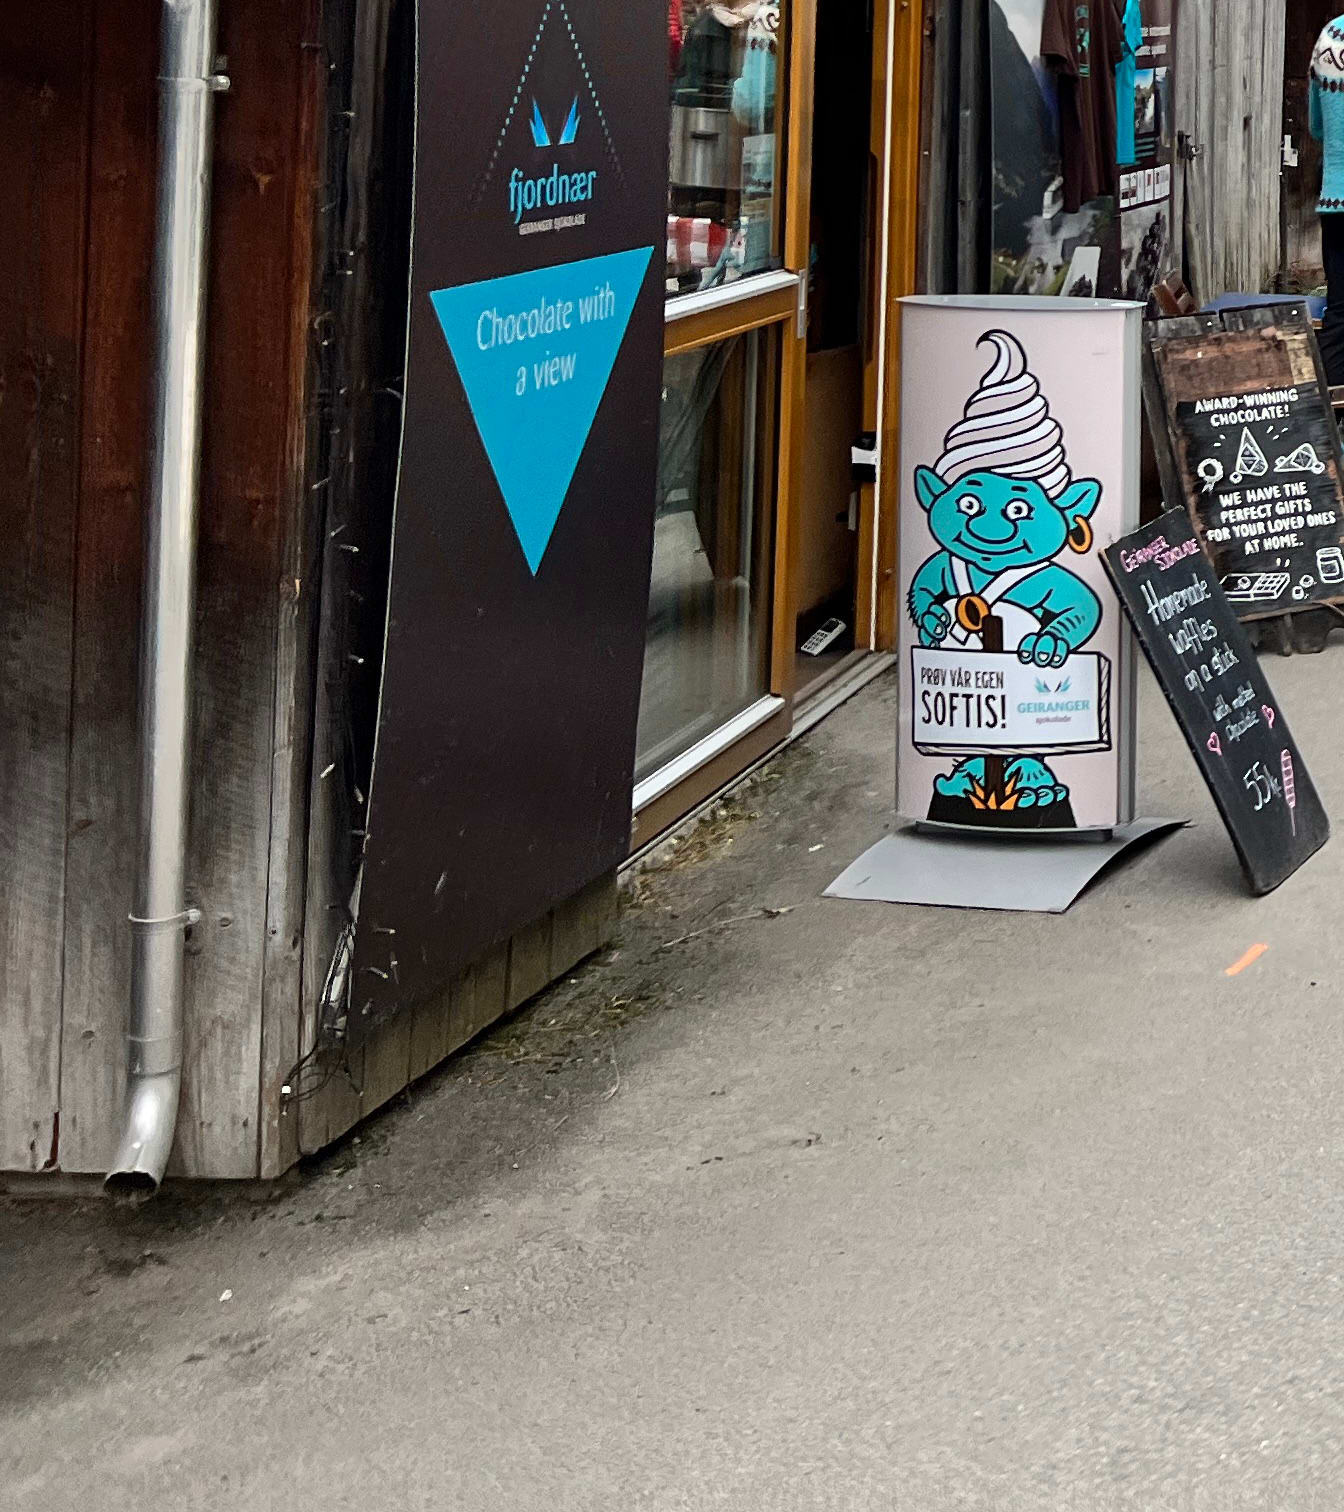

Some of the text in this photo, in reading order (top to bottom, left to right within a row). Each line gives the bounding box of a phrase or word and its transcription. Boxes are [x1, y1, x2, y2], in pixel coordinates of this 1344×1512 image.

[509, 163, 597, 224] fjordnær
[477, 281, 615, 350] Chocolate with
[515, 350, 577, 396] a view
[1195, 388, 1299, 414] AWARD-WINNING
[1210, 404, 1290, 427] CHOCOLATE!
[1219, 481, 1308, 508] WE HAVE THE
[1220, 498, 1312, 524] PERFECT GIFTS
[1206, 510, 1336, 542] FOR YOUR LOVED ONES
[1244, 533, 1304, 556] AT HOME.
[1141, 573, 1211, 626] Homemade
[1168, 617, 1217, 656] waffles
[920, 666, 1004, 690] PRØV VÅR EGEN
[921, 690, 1007, 729] SOFTIS!
[1017, 699, 1090, 714] GEIRANGER
